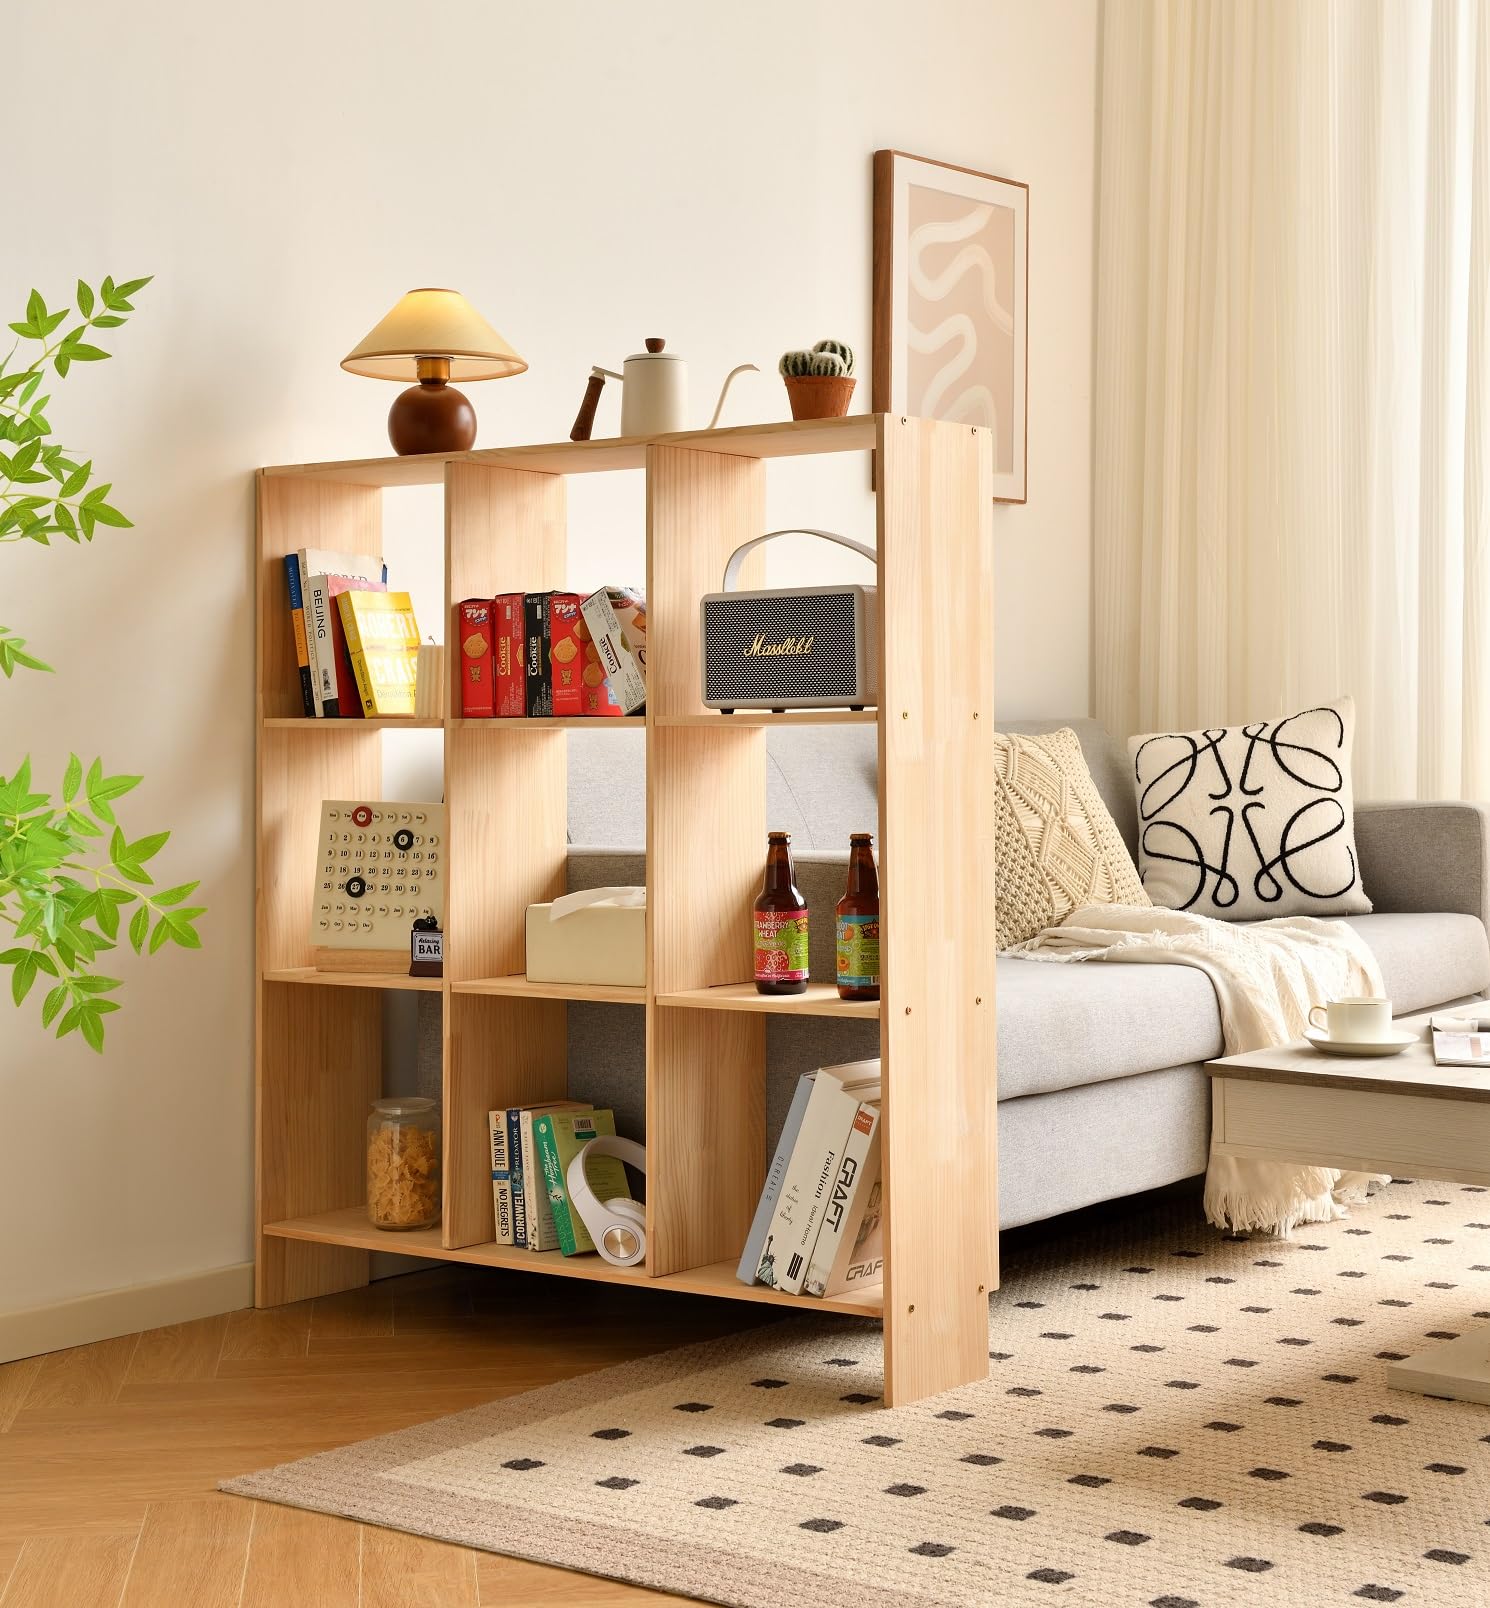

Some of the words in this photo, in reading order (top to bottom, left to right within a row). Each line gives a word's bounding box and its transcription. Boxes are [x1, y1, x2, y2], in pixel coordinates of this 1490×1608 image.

[313, 589, 326, 639] BEIJING
[465, 608, 488, 619] マンナ
[554, 604, 577, 614] マンナ
[499, 636, 507, 676] Cookie
[530, 636, 538, 676] Cookie
[600, 637, 618, 674] Cookie
[418, 944, 441, 955] BAR
[493, 1129, 505, 1146] ANN
[494, 1148, 506, 1168] RULE
[550, 1151, 560, 1177] Tree
[815, 1150, 835, 1199] Fashion
[498, 1188, 508, 1200] NO
[825, 1156, 858, 1233] CRAFT
[500, 1202, 510, 1237] REGRETS
[514, 1188, 526, 1239] CORNWELL
[846, 1259, 884, 1281] CRAF
